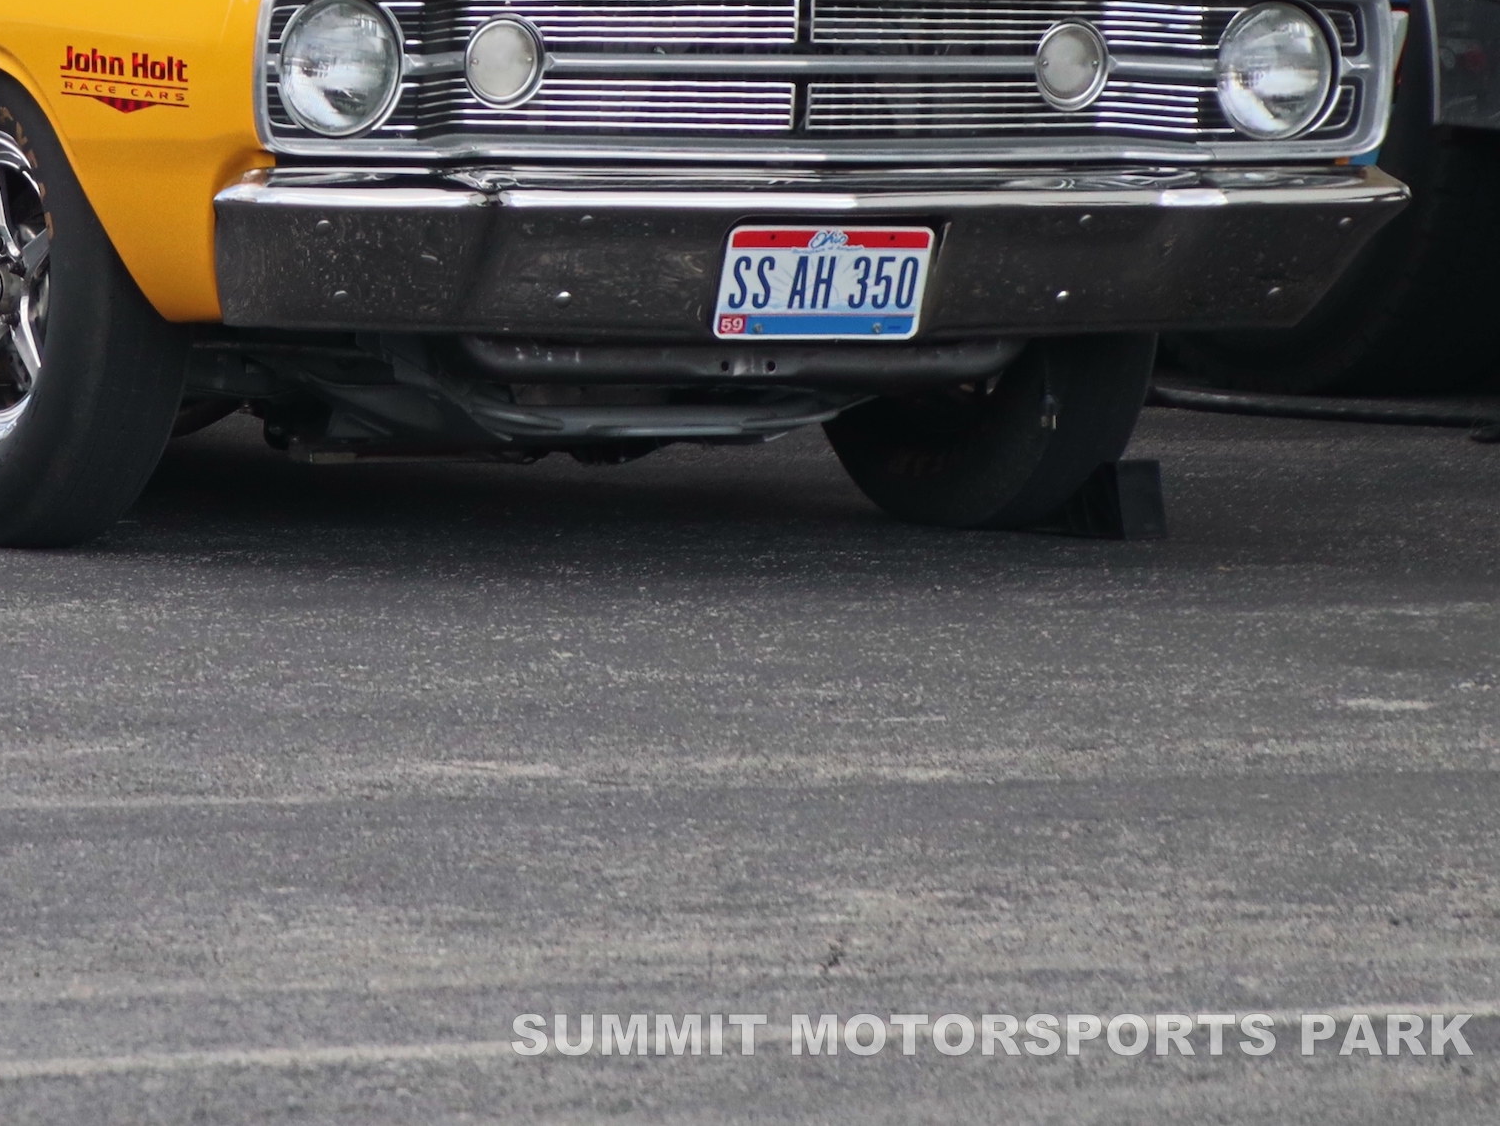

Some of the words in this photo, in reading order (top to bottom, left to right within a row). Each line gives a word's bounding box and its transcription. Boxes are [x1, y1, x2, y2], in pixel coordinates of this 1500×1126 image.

[60, 45, 125, 77] John
[131, 52, 189, 83] Holt
[63, 80, 117, 94] RACE
[130, 86, 186, 102] CARS
[728, 256, 776, 309] SS
[787, 256, 836, 309] AH
[848, 256, 919, 309] 350
[720, 318, 744, 333] 59
